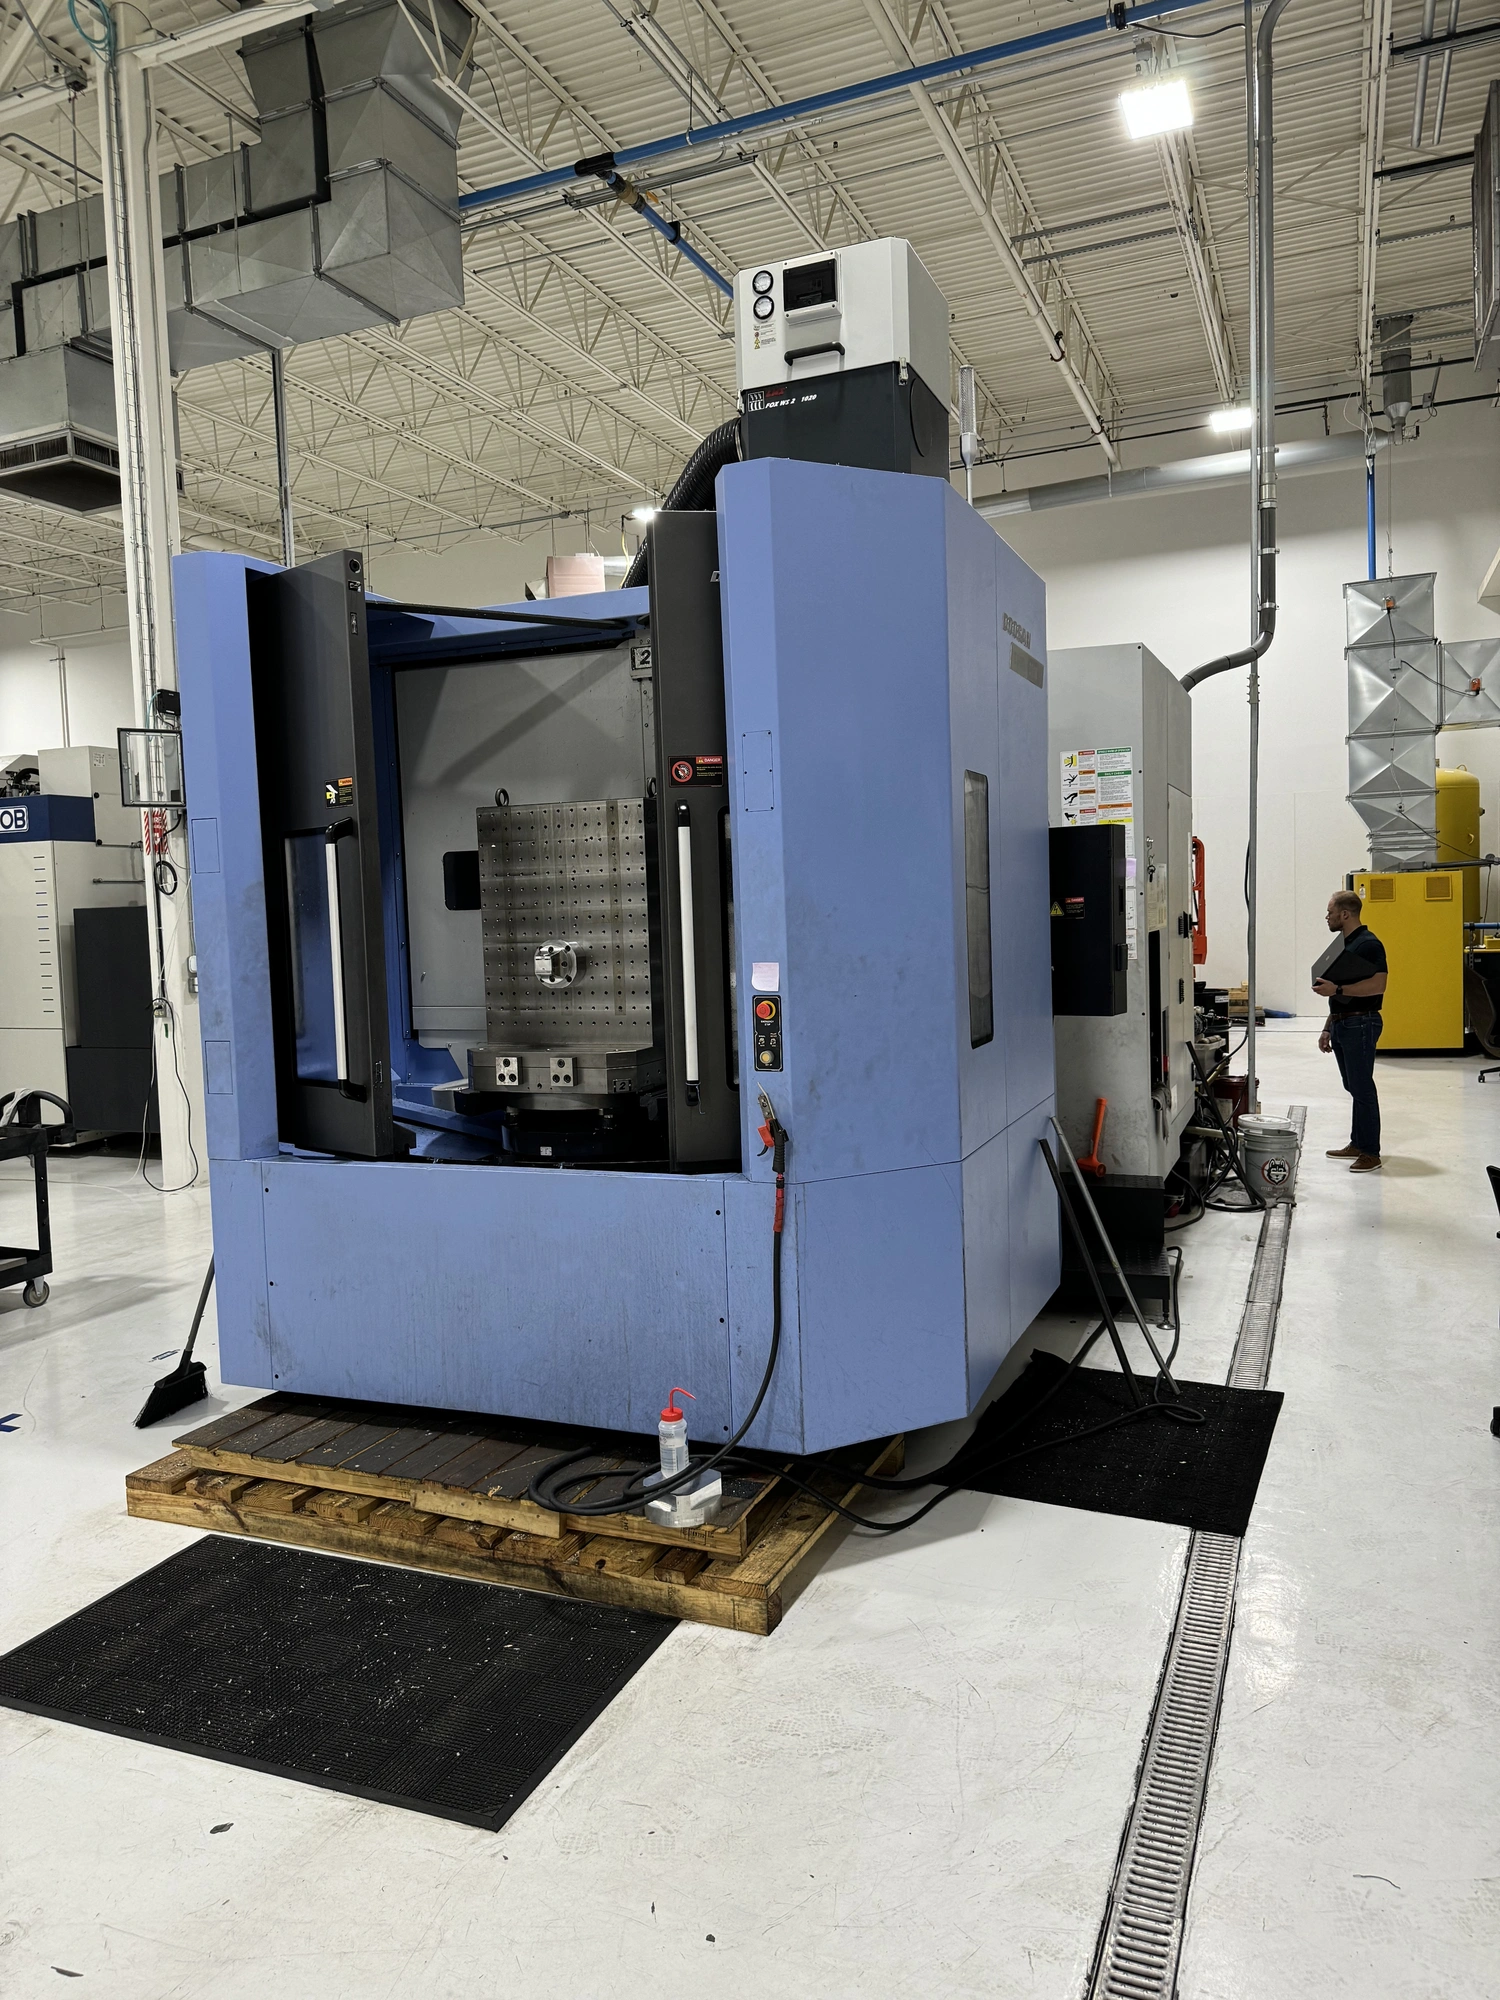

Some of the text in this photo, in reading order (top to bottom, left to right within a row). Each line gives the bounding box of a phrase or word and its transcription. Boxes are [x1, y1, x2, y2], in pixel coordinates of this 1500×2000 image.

[765, 401, 780, 409] FOX
[640, 649, 651, 665] 2
[619, 1081, 626, 1091] 2
